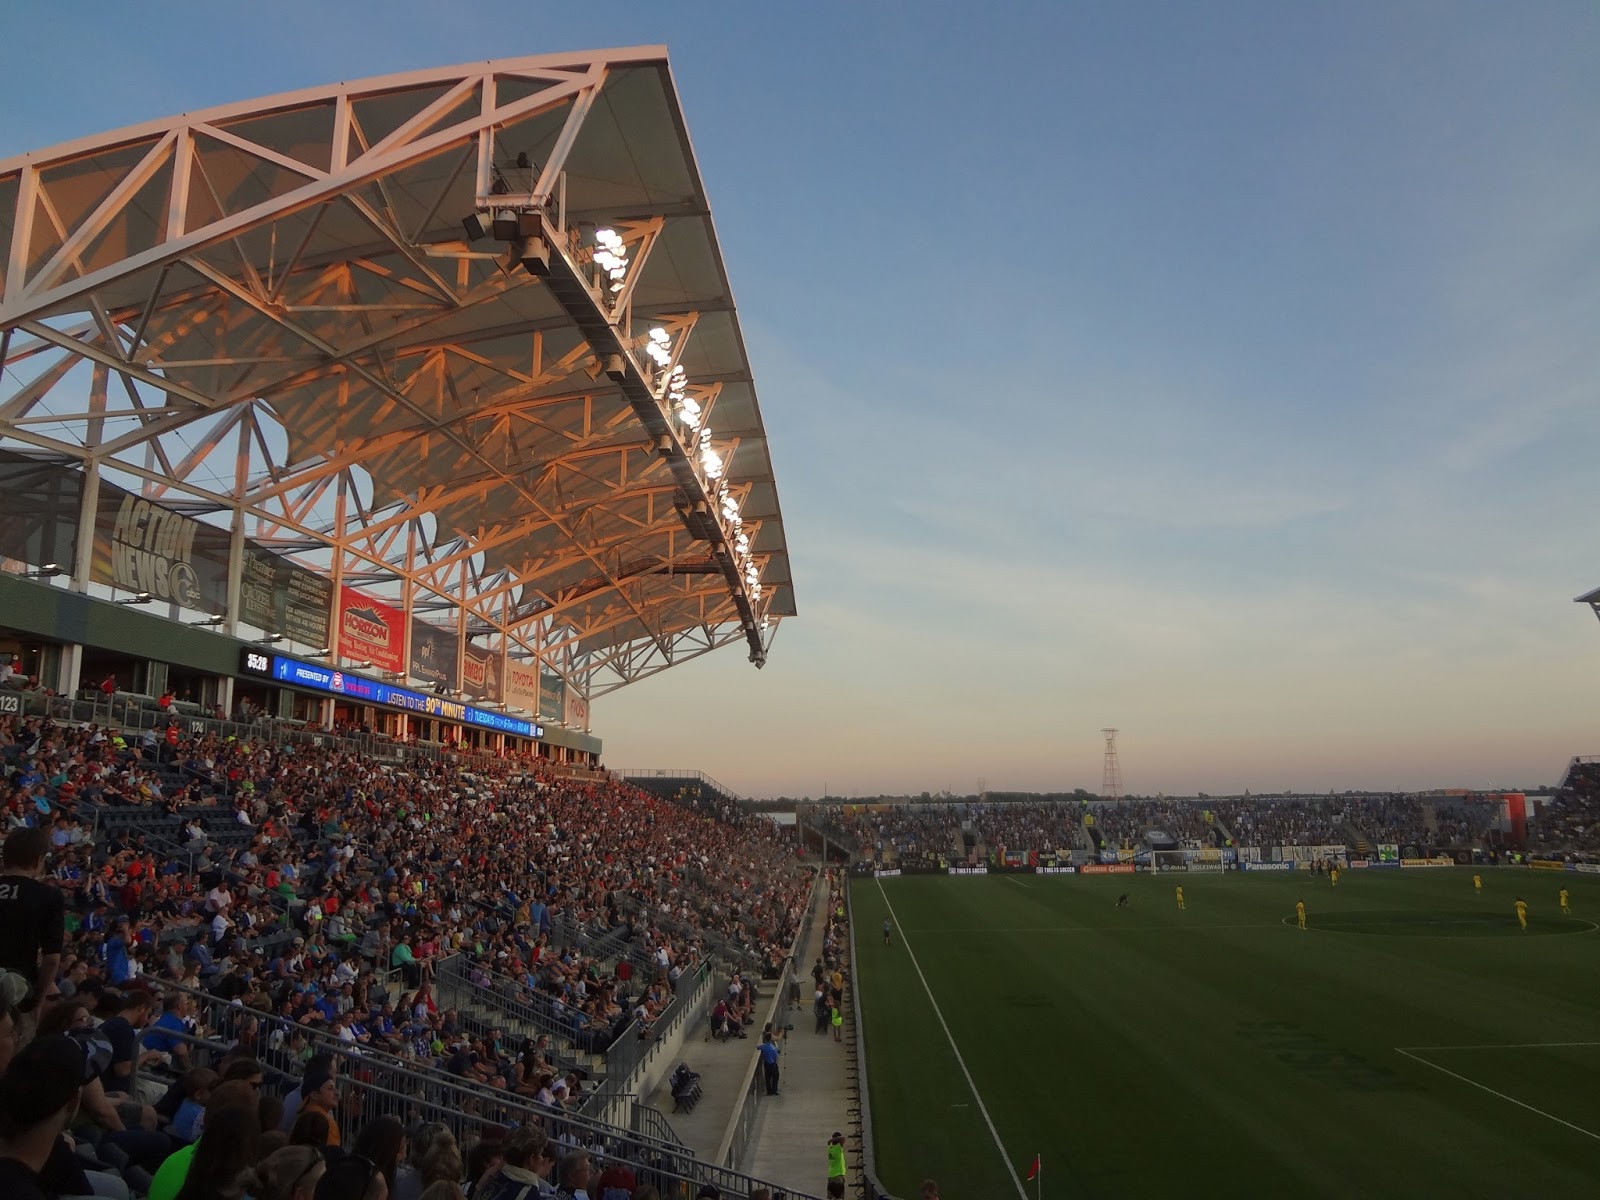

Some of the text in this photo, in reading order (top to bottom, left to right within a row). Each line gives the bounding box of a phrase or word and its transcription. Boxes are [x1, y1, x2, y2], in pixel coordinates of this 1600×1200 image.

[113, 494, 198, 564] ACTION
[112, 540, 170, 598] NEWS
[186, 589, 201, 599] abc
[345, 612, 388, 640] HORIZON
[412, 661, 421, 673] PPL
[296, 668, 330, 683] PRESENTED BY
[512, 670, 534, 688] TOYOTA
[0, 696, 18, 712] 123
[388, 692, 406, 706] LISTEN
[407, 696, 415, 707] TO
[415, 698, 425, 711] THE
[442, 701, 466, 720] MINUTE
[474, 711, 495, 725] TUESDAYS
[192, 721, 204, 733] 124
[1245, 862, 1290, 870] Panasonic
